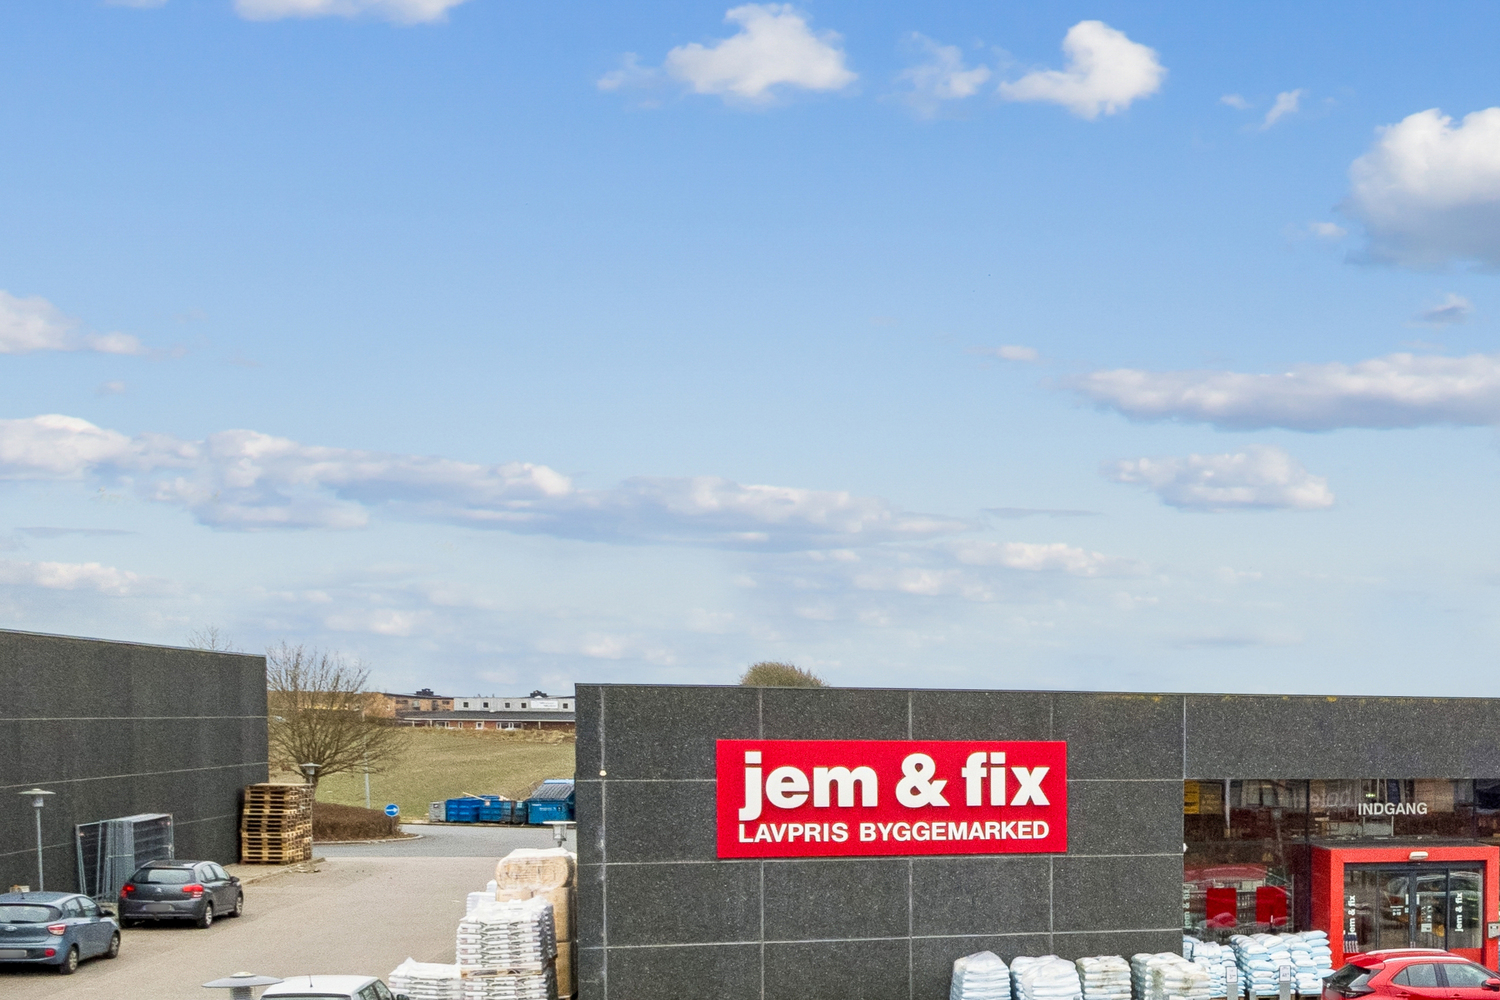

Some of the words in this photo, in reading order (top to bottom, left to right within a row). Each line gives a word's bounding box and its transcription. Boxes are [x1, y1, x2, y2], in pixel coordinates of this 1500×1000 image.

[738, 750, 878, 821] jem
[895, 752, 950, 808] &
[961, 751, 1051, 806] fix
[1358, 802, 1428, 815] INDGANG
[738, 822, 849, 843] LAVPRIS
[859, 820, 1050, 842] BYGGEMARKED
[1347, 908, 1356, 916] &
[1454, 905, 1463, 913] &
[1347, 917, 1357, 936] jem
[1454, 914, 1464, 932] jem
